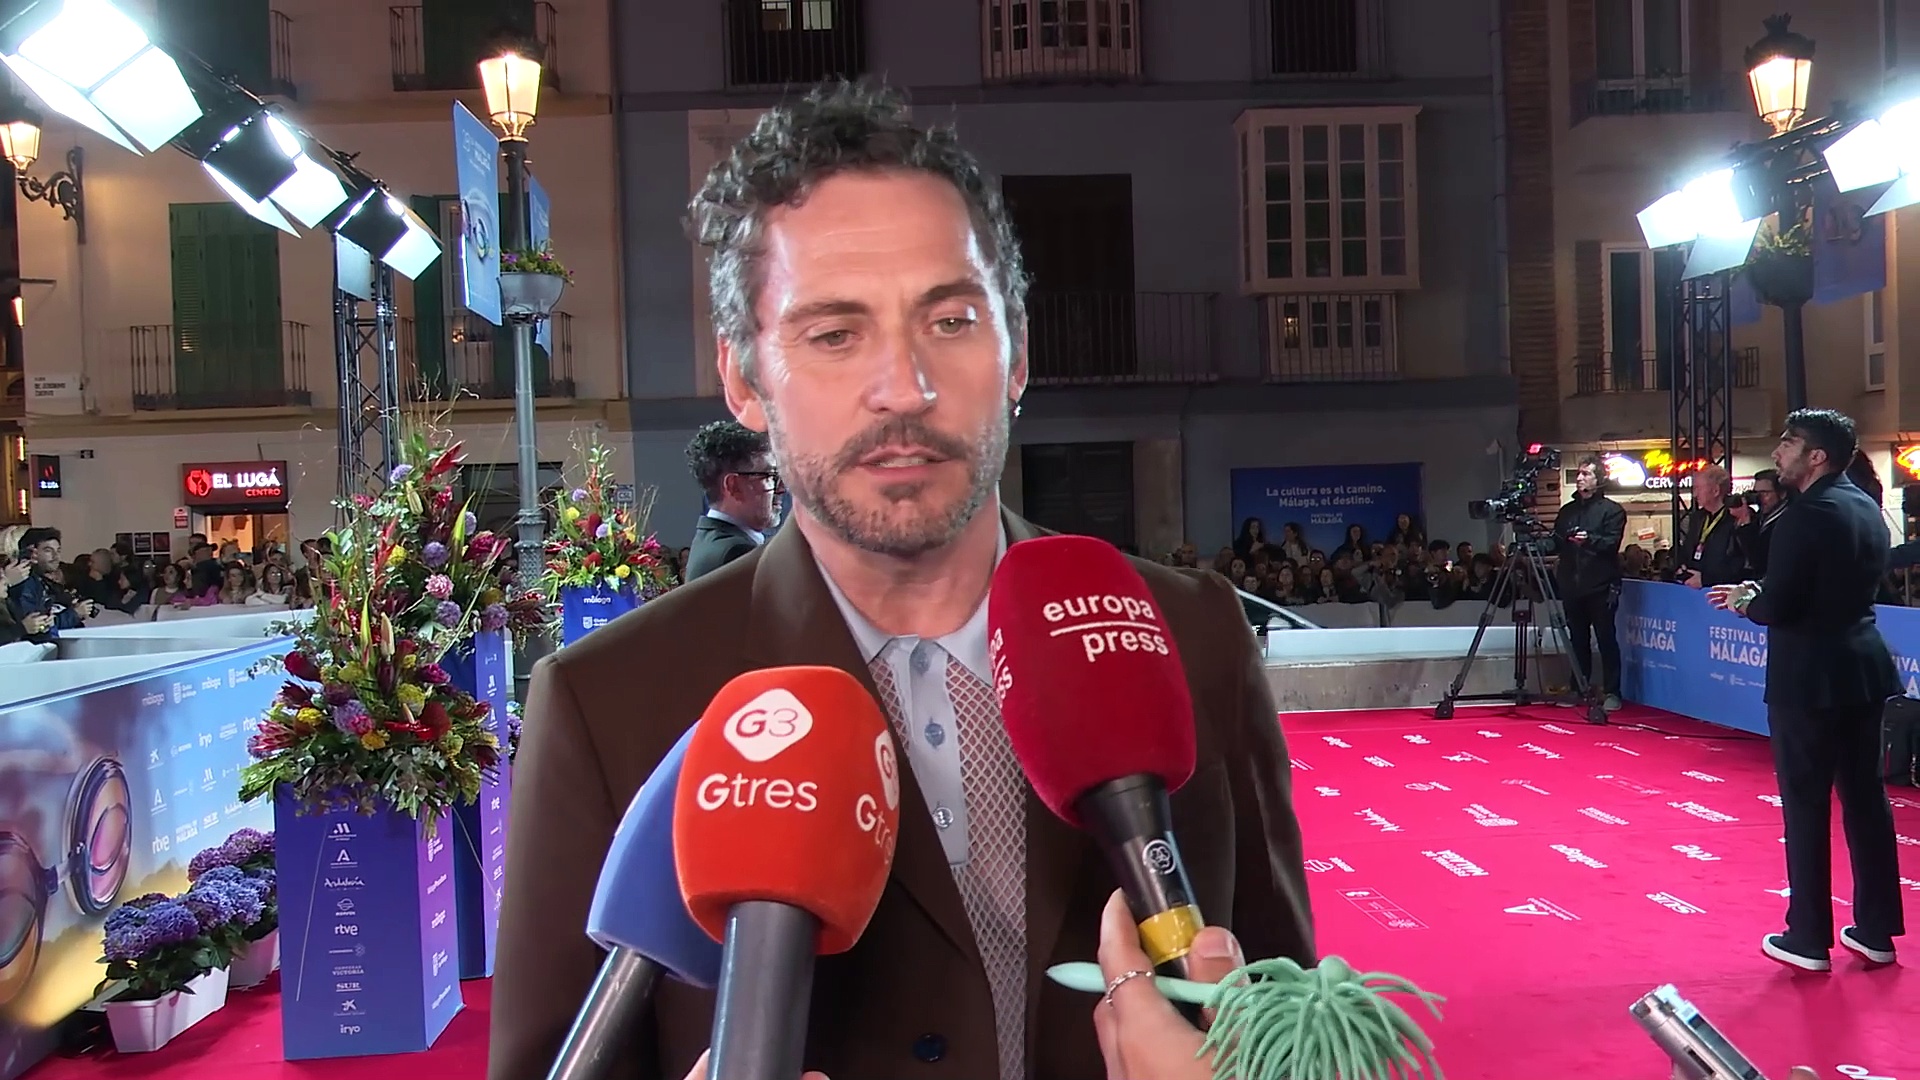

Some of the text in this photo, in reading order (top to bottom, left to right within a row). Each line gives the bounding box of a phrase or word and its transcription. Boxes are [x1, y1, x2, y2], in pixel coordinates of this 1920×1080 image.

[212, 472, 232, 489] EL
[1645, 476, 1692, 489] CERVNT
[245, 488, 281, 497] CENTRO
[1266, 483, 1387, 497] La cultura es el camino.
[1279, 495, 1374, 508] Málaga, el destino.
[1042, 594, 1156, 622] europa
[1665, 619, 1676, 632] DE
[1710, 626, 1766, 645] FESTIVAL D
[1081, 630, 1169, 662] press
[1710, 640, 1767, 668] MÁLAGA
[736, 707, 799, 738] G3
[696, 772, 819, 812] Gtres
[856, 793, 892, 864] Gtre
[334, 923, 359, 936] rtve
[340, 1023, 361, 1035] iryo
